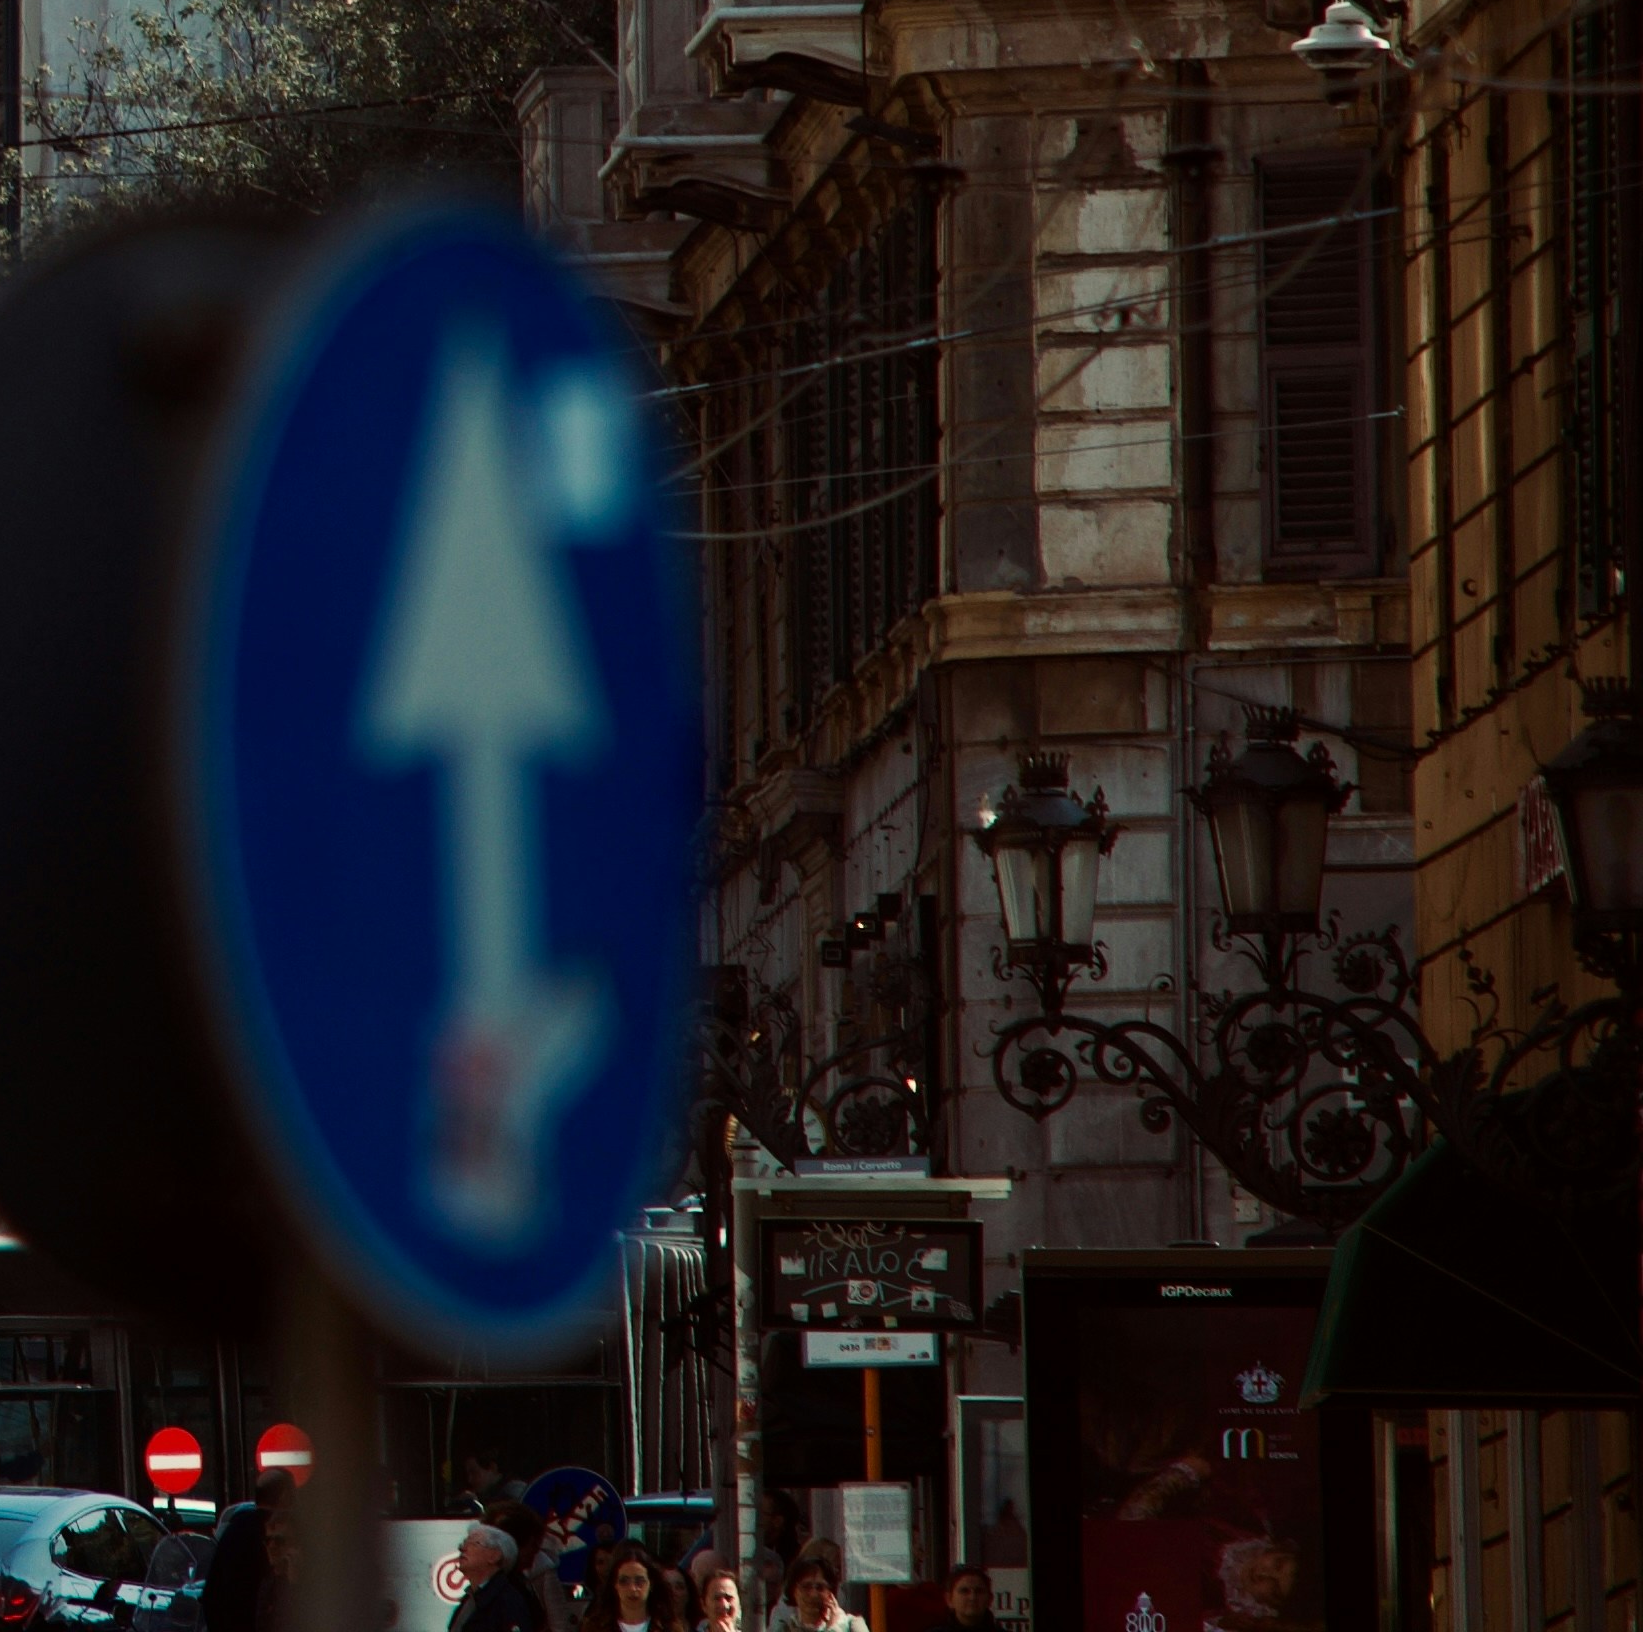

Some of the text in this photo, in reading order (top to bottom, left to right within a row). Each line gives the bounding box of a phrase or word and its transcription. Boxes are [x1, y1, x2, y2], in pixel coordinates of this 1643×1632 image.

[823, 1160, 851, 1171] Roma
[859, 1160, 902, 1171] Corvetto
[1160, 1285, 1233, 1299] IGPDecaux
